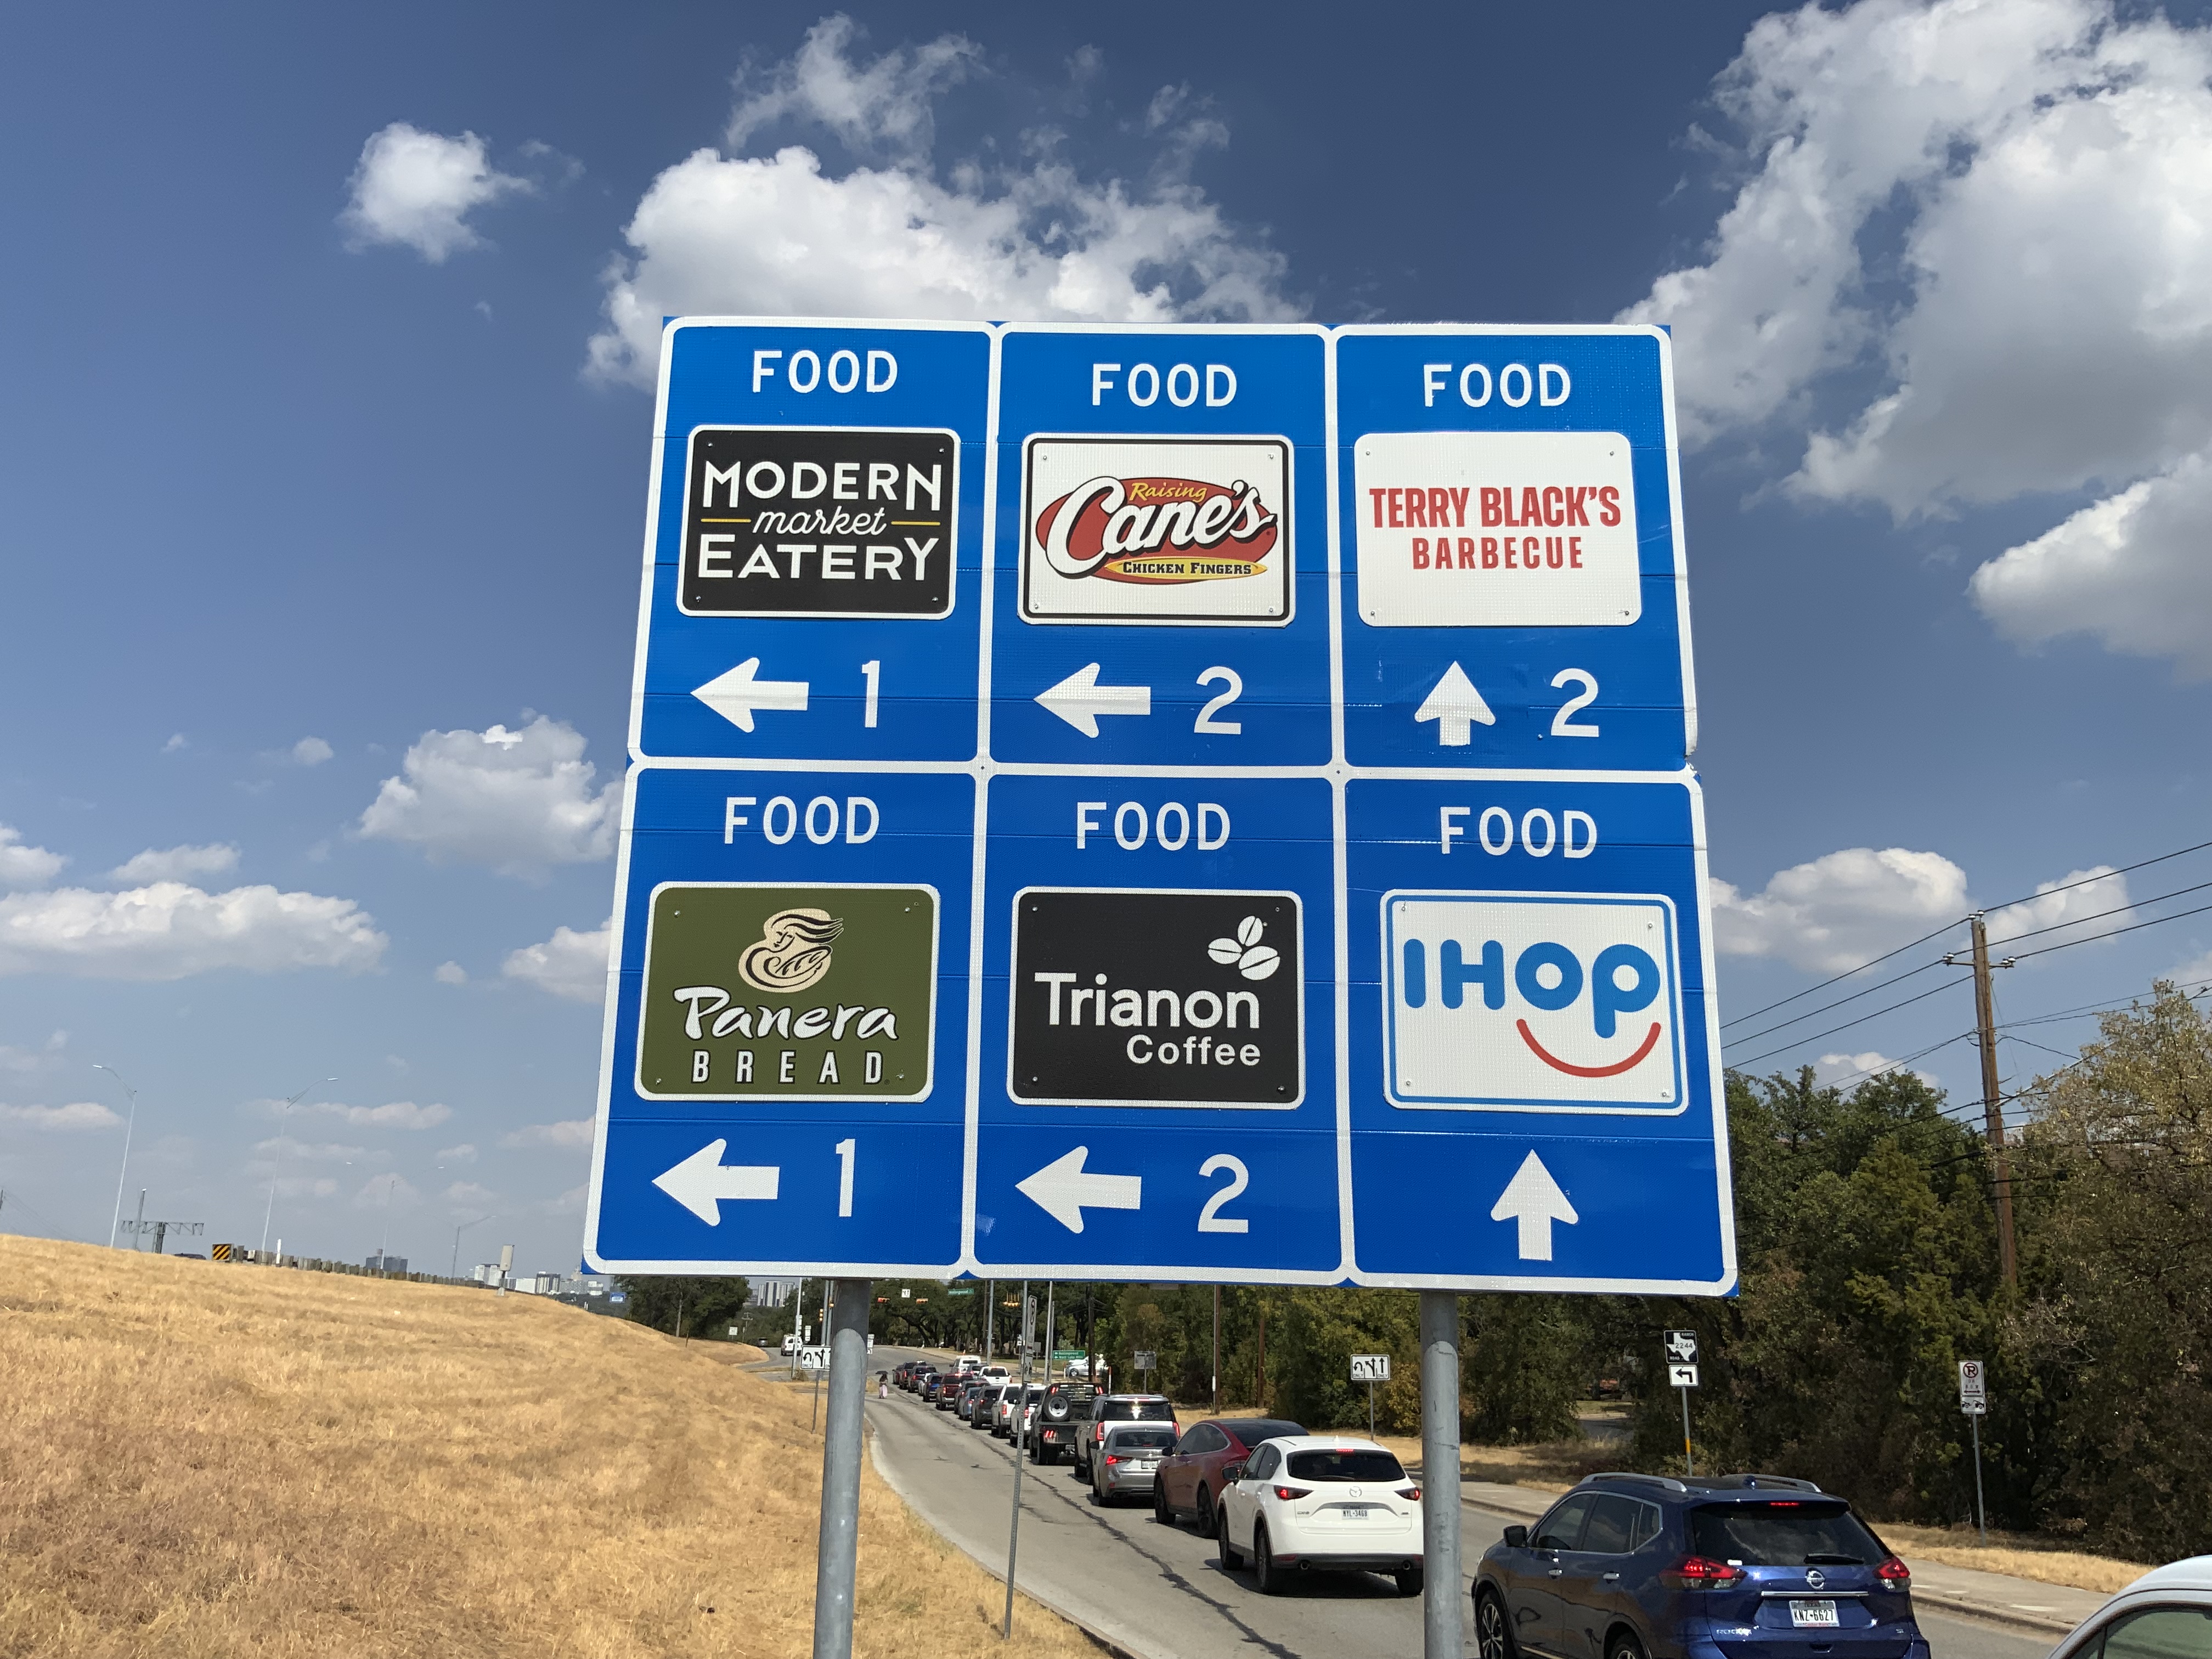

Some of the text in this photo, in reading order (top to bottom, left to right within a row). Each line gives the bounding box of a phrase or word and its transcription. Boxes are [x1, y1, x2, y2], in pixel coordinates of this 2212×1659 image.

[752, 349, 898, 393] FOOD
[1092, 363, 1237, 407] FOOD
[1423, 363, 1571, 407] FOOD
[702, 460, 942, 511] MODERN
[1129, 482, 1207, 503] Raising
[1369, 486, 1622, 528] TERRY BLACK'S
[752, 506, 888, 536] market
[1046, 476, 1278, 579] Cane's
[697, 533, 939, 581] EATERY
[1122, 561, 1252, 575] CHICKEN FINGERS
[1412, 536, 1583, 570] BARBECUE
[861, 660, 881, 729] 1
[1193, 665, 1243, 735] 2
[1550, 668, 1600, 738] 2
[724, 795, 880, 845] FOOD
[1076, 802, 1231, 850] FOOD
[1440, 806, 1598, 859] FOOD
[673, 986, 899, 1041] Panera
[1034, 972, 1260, 1029] Trianon
[691, 1050, 884, 1085] BREAD
[1126, 1034, 1261, 1066] Coffee
[835, 1138, 856, 1217] 1
[1197, 1153, 1249, 1233] 2
